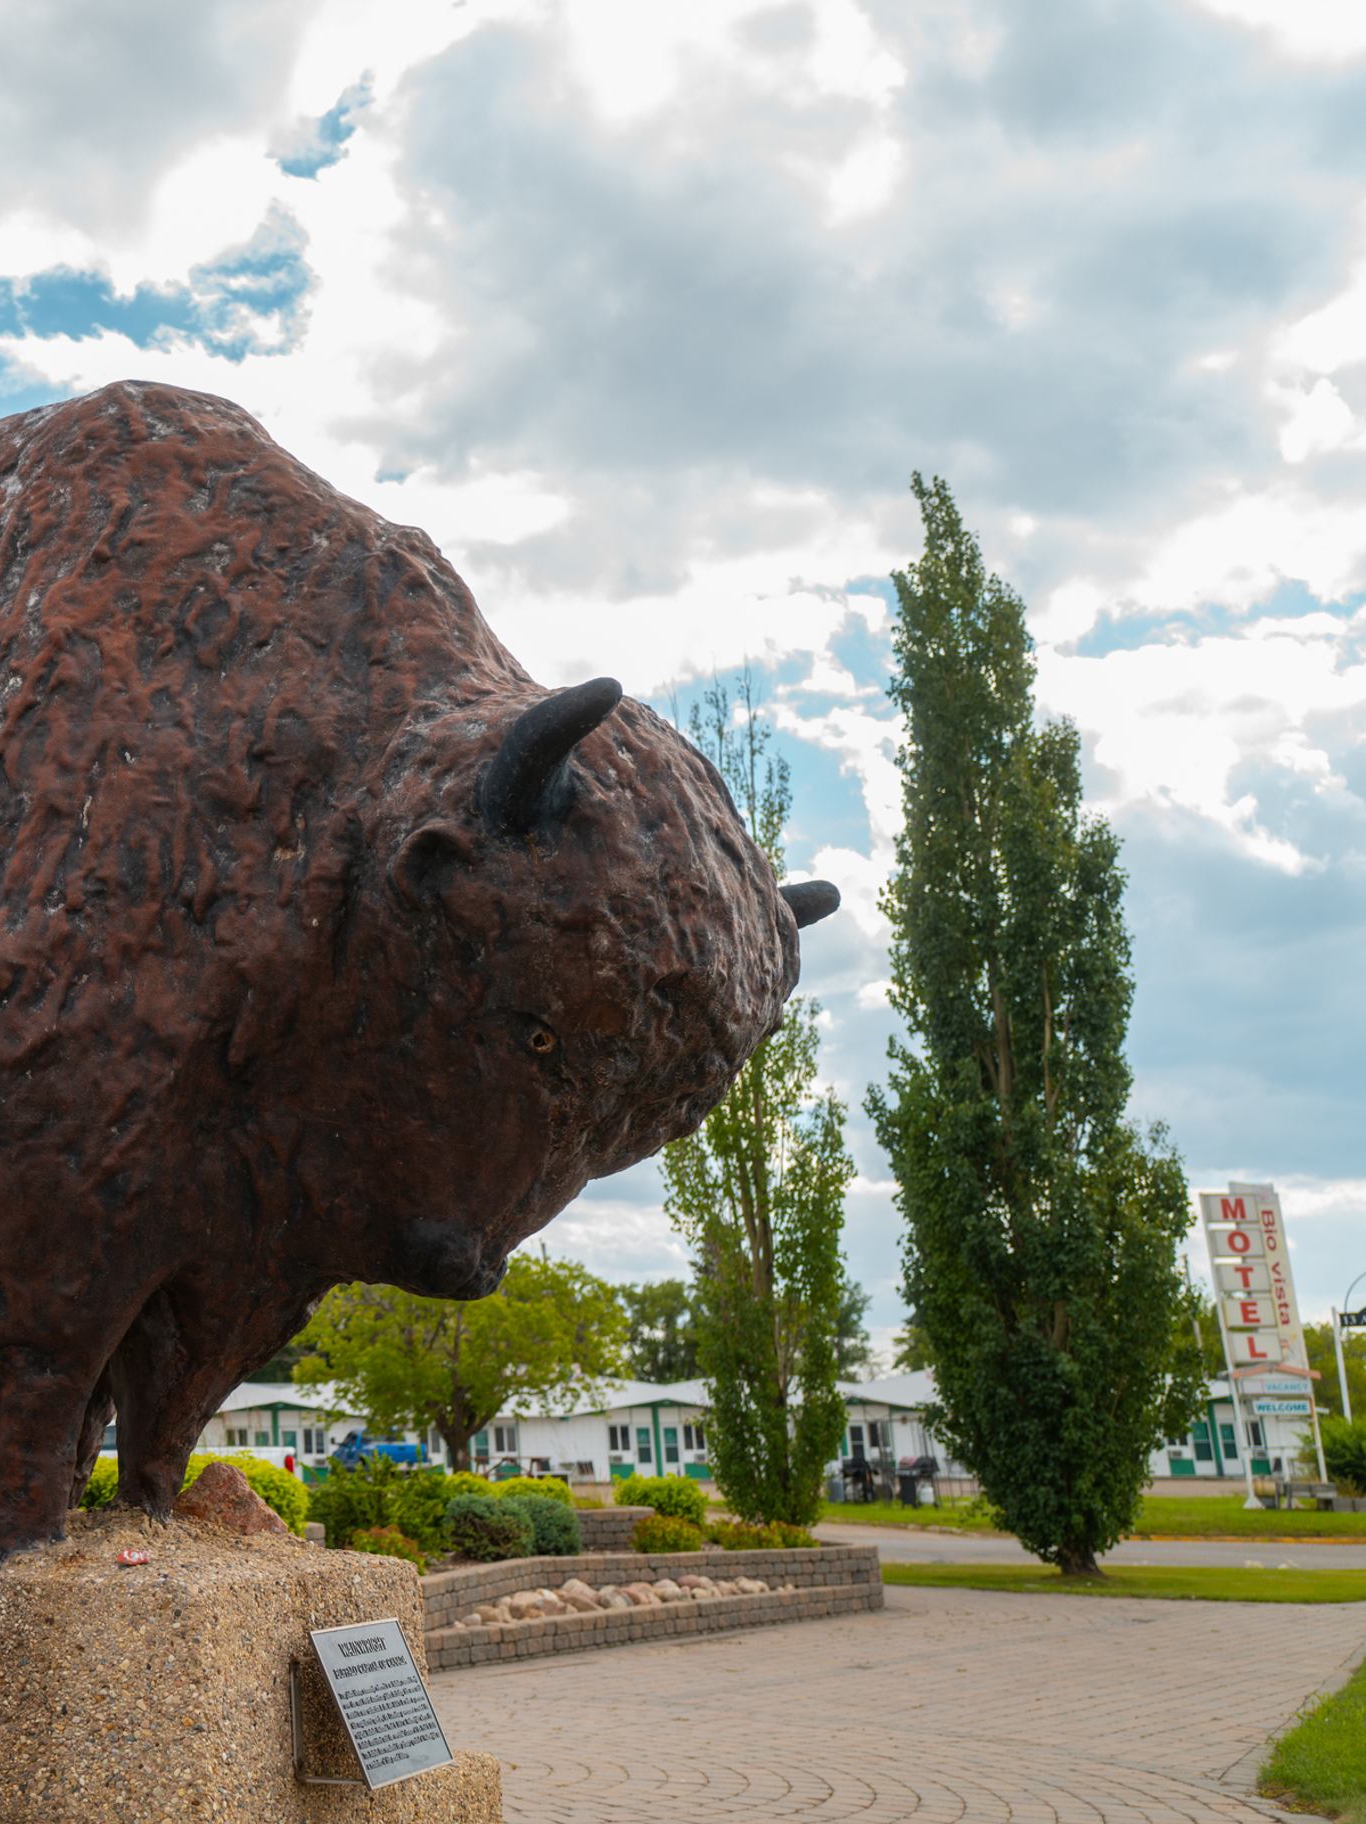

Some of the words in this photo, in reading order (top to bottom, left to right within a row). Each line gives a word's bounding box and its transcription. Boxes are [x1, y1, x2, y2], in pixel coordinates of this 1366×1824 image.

[1220, 1198, 1268, 1359] MOTEL
[1265, 1383, 1308, 1392] VACANCY
[1257, 1402, 1307, 1412] WELCOME
